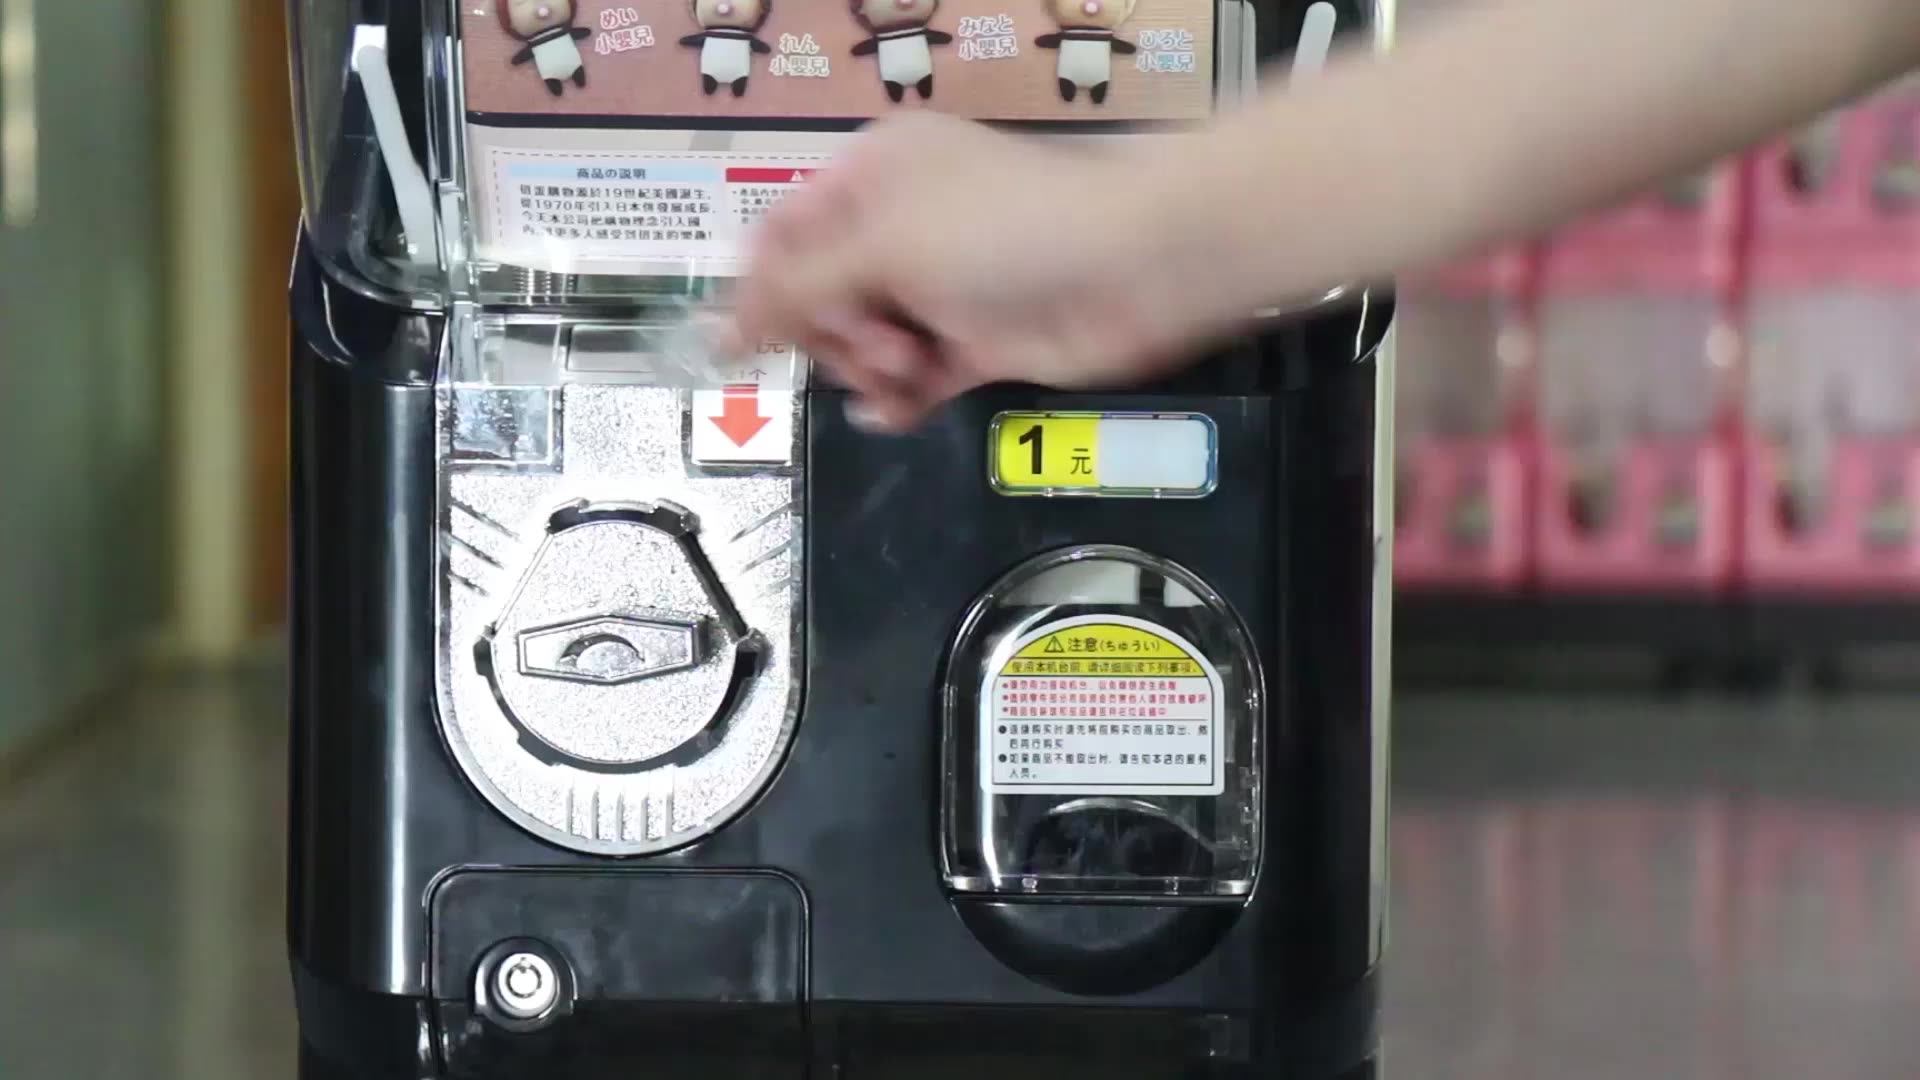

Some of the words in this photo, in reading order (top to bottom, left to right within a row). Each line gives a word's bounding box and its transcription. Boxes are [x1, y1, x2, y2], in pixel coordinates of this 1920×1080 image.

[600, 8, 638, 29] めい
[959, 15, 1014, 37] みなと
[779, 33, 820, 54] れん
[1138, 30, 1193, 50] ひろと
[576, 168, 646, 179] 商品の説明
[1019, 425, 1043, 475] 1
[1070, 448, 1092, 474] 元
